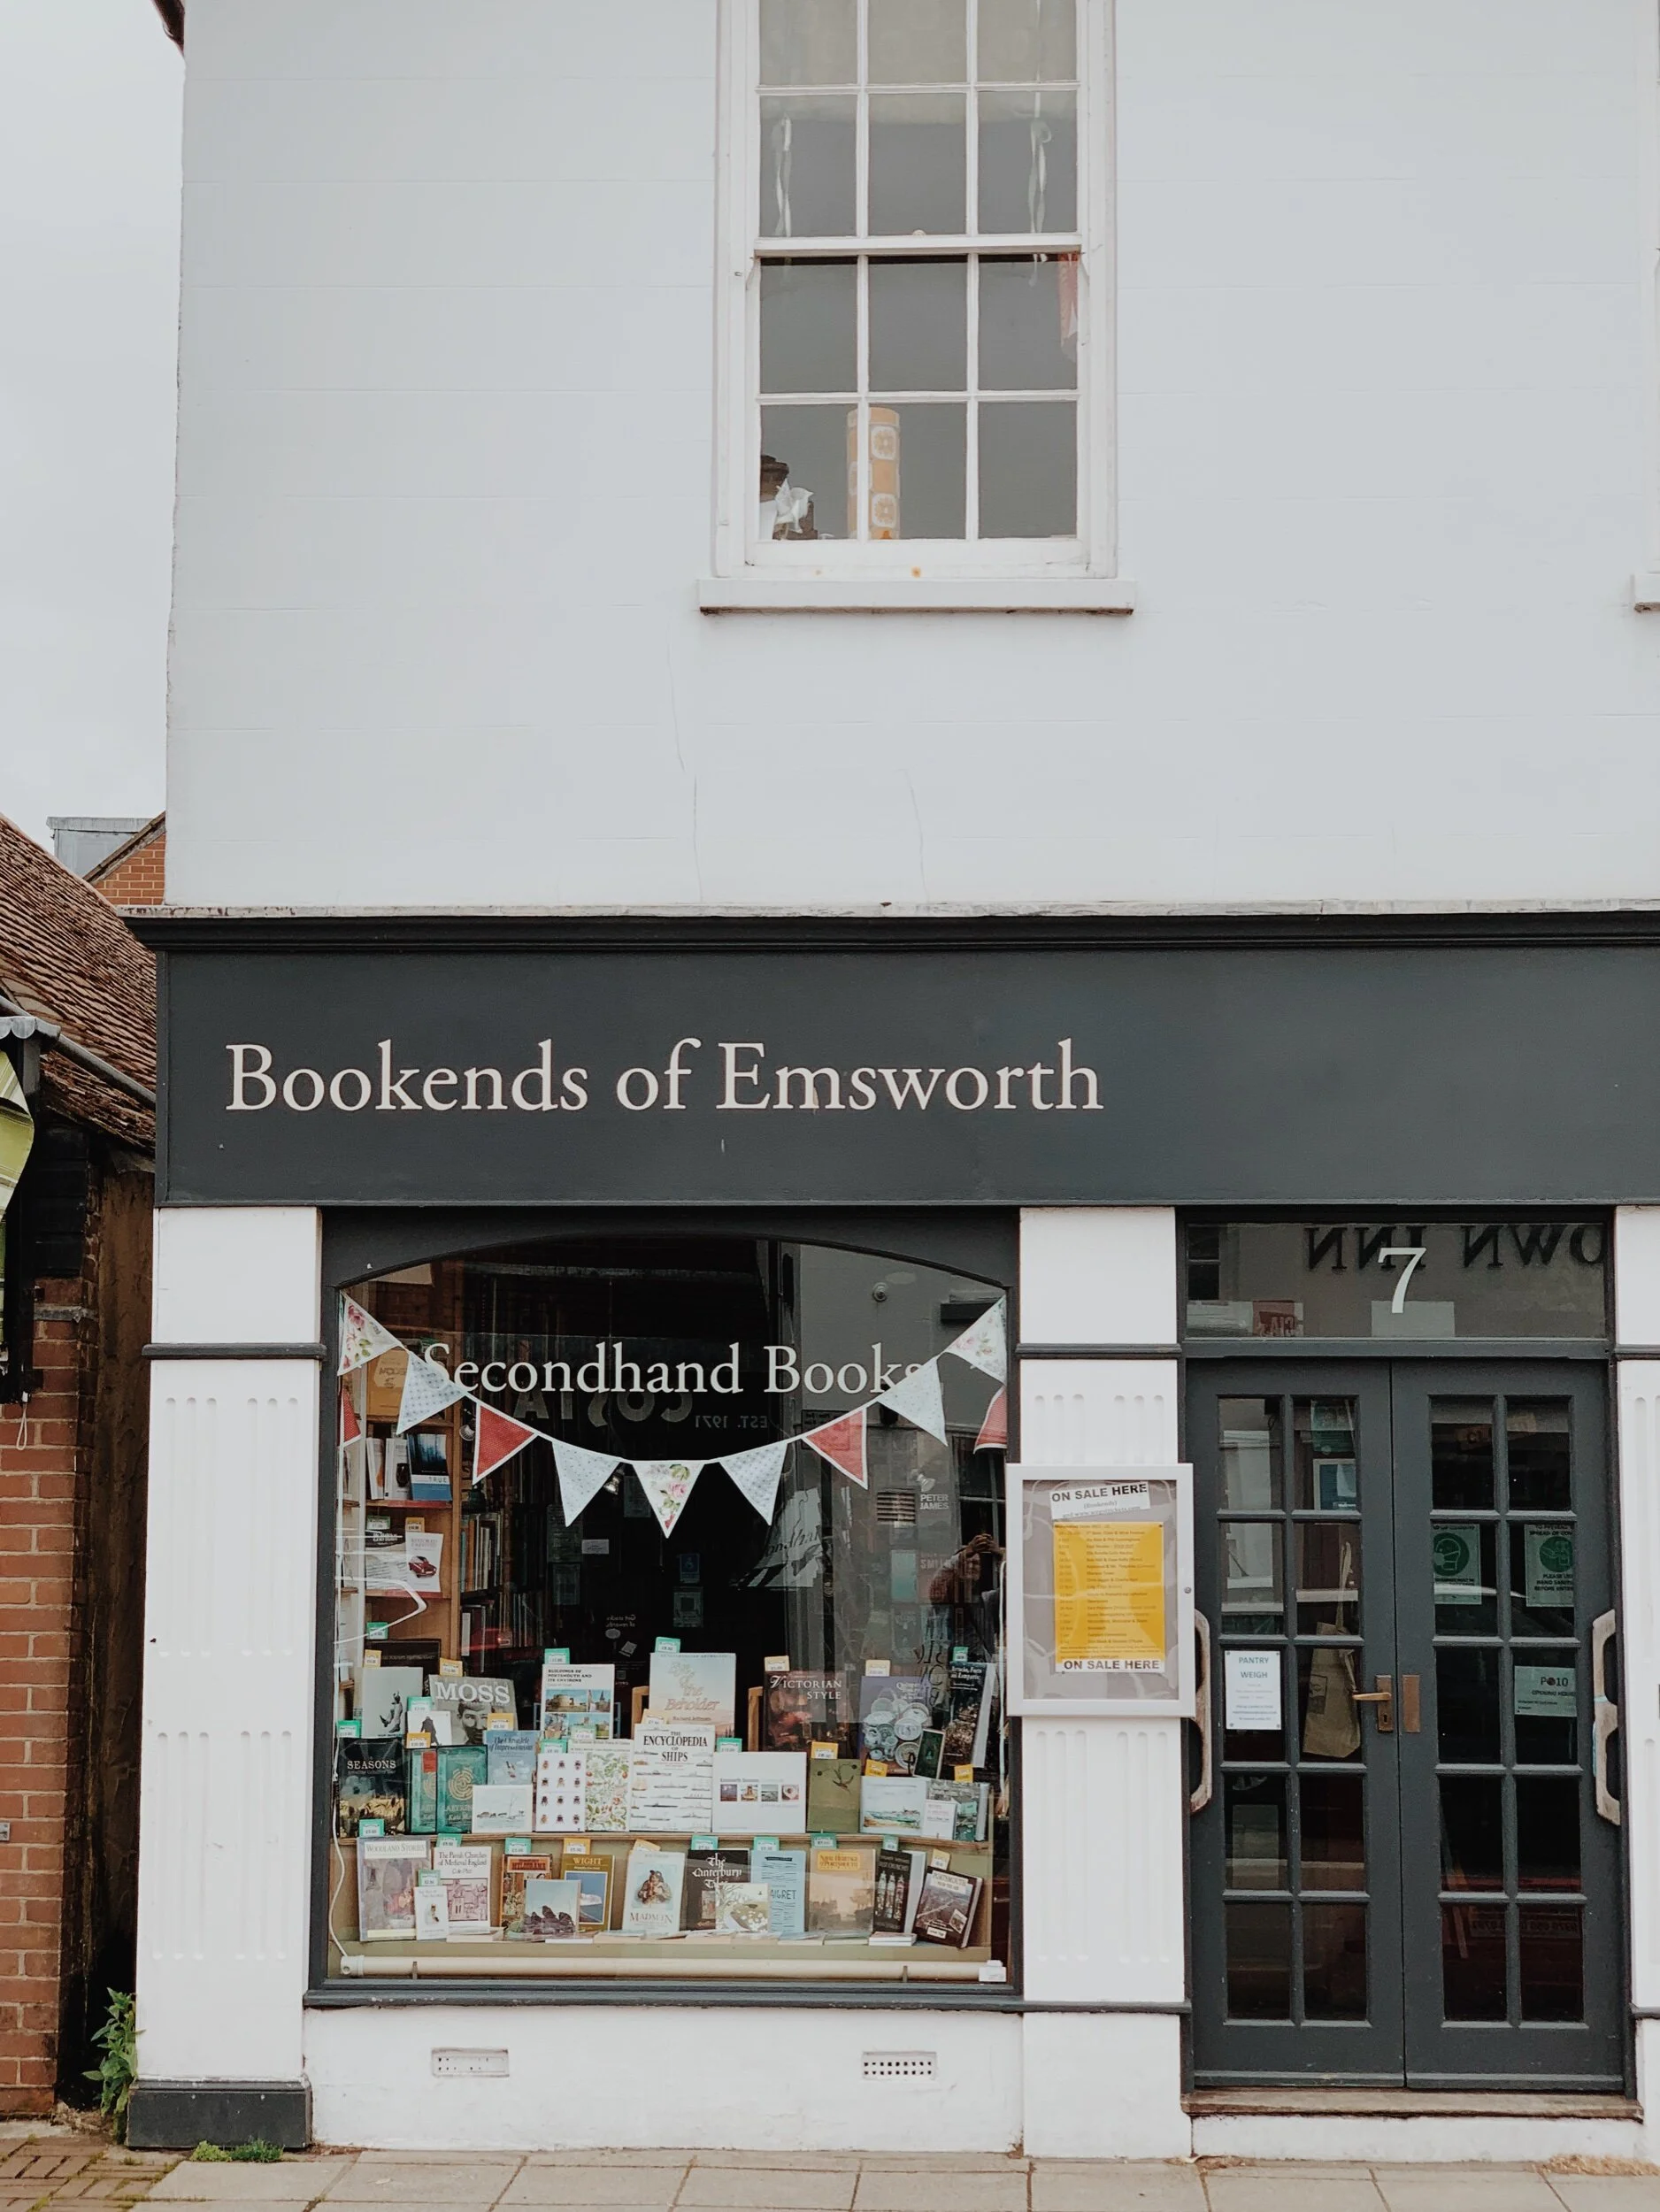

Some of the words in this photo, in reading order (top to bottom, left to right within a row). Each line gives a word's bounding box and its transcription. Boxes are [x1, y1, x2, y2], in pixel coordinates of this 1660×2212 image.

[226, 1039, 588, 1113] Bookends
[616, 1037, 701, 1111] of
[718, 1039, 1103, 1114] Emsworth
[1378, 1248, 1427, 1315] 7
[423, 1342, 743, 1395] Secondhand
[1051, 1491, 1071, 1502] ON
[1075, 1487, 1108, 1500] SALE
[1111, 1483, 1148, 1496] HERE
[1064, 1660, 1082, 1670] ON
[1087, 1660, 1119, 1670] SALE
[1125, 1660, 1160, 1670] HERE
[770, 1675, 842, 1689] VICTORIAN
[434, 1681, 511, 1705] MOSS
[807, 1691, 842, 1700] STYLE
[665, 1697, 721, 1711] Beholder
[643, 1735, 708, 1747] ENCYCLOPEDIA
[661, 1751, 688, 1762] SHIPS
[347, 1760, 396, 1770] SEASONS
[366, 1843, 400, 1853] WOODLAND
[401, 1843, 426, 1853] STORIES
[705, 1852, 726, 1869] The
[691, 1867, 742, 1878] Canterbury
[770, 1889, 797, 1900] AIGRET
